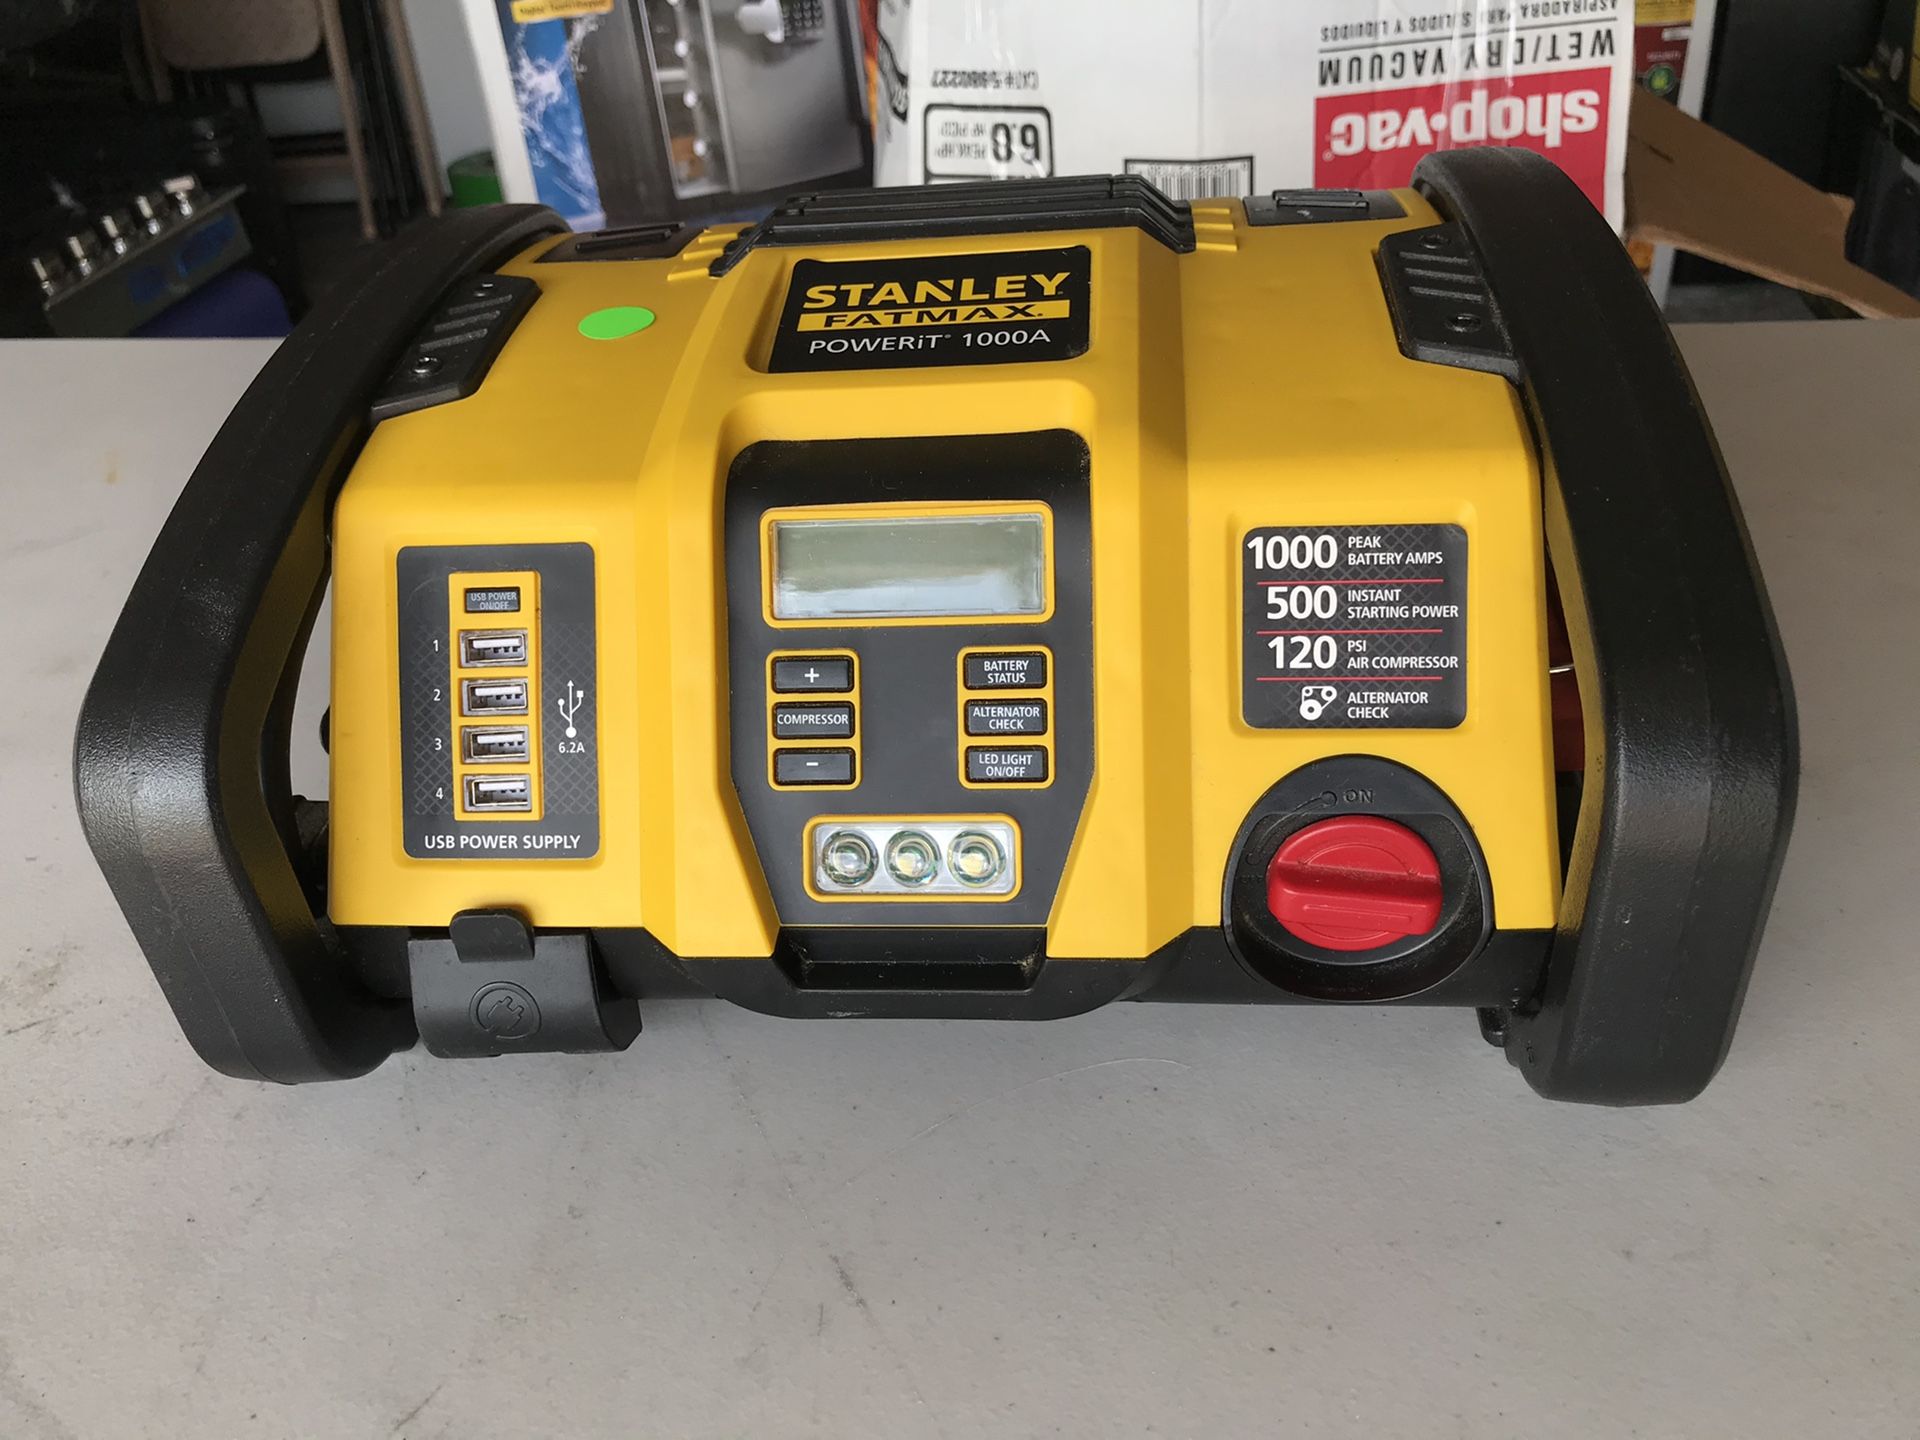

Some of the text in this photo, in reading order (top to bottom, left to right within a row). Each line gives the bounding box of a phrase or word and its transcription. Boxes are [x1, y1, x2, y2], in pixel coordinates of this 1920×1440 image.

[1394, 18, 1404, 35] Y
[1409, 11, 1472, 33] SLIDOS
[1318, 28, 1615, 87] WET/DRY VACUUM
[803, 271, 1071, 309] STANLEY
[823, 304, 1038, 328] FATMAX
[962, 329, 1051, 347] 1000A
[1347, 536, 1382, 549] PEAK
[1247, 534, 1338, 570] 1000
[1347, 552, 1444, 565] BATTERY AMPS
[470, 591, 517, 601] USB POWER
[1347, 589, 1402, 601] INSTANT
[1266, 585, 1338, 620] 500
[1347, 605, 1459, 619] STARTING POWER
[432, 639, 440, 652] 1
[1347, 639, 1367, 652] PSI
[1267, 635, 1338, 670] 120
[983, 660, 1030, 672] BATTERY
[1347, 655, 1459, 669] AIR COMPRESSOR
[987, 672, 1027, 684] STATUS
[433, 689, 441, 702] 2
[1347, 691, 1429, 704] ALTERNATOR
[777, 713, 849, 725] COMPRESSOR
[973, 706, 1041, 719] ALTERNATOR
[1347, 706, 1390, 719] CHECK
[989, 718, 1025, 730] CHECK
[434, 738, 442, 751] 3
[558, 741, 586, 754] 6.2A
[979, 753, 1033, 766] LED LIGHT
[985, 765, 1026, 778] ON/OFF
[435, 787, 444, 800] 4
[1343, 789, 1374, 803] ON
[424, 834, 581, 850] USB POWER SUPPLY
